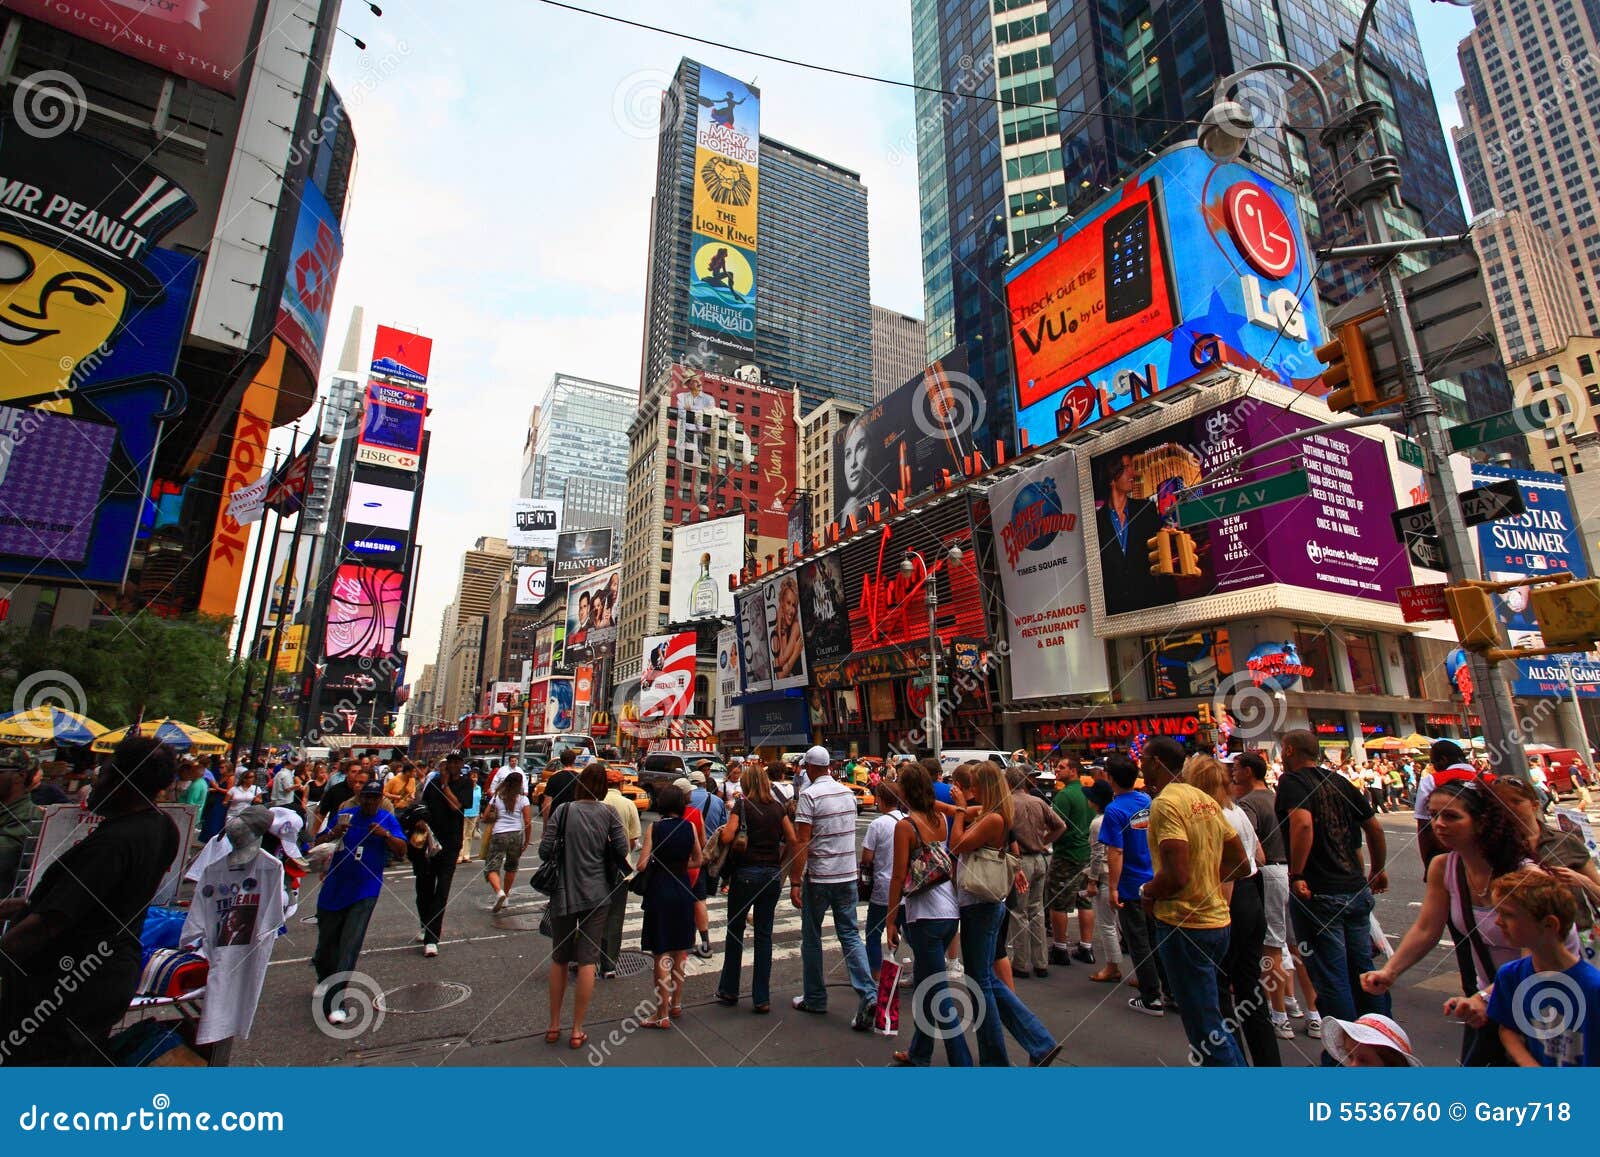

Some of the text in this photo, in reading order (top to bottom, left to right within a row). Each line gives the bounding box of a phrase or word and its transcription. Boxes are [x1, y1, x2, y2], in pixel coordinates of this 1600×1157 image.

[176, 51, 232, 80] STYLE
[700, 131, 757, 162] POPPINS
[709, 124, 750, 149] MARY
[0, 176, 147, 259] MR. PEANUT
[717, 210, 737, 224] THE
[696, 215, 755, 245] LION KING
[1012, 268, 1097, 325] Check out the
[691, 303, 754, 333] MERMAID
[705, 303, 742, 317] THE LITTLE
[1080, 311, 1091, 322] by
[1091, 300, 1104, 315] LG
[1240, 274, 1309, 342] LG
[379, 395, 416, 408] PREMIER
[380, 387, 404, 399] HSBC
[764, 394, 788, 448] Valdez
[1472, 424, 1486, 442] 7
[360, 448, 397, 464] HSBC
[1204, 458, 1211, 469] A
[1211, 446, 1243, 468] NIGHT
[1303, 457, 1322, 472] PLANET
[1326, 451, 1340, 464] MORE
[1340, 456, 1348, 466] TO
[764, 450, 788, 496] Juan
[1214, 489, 1266, 513] 7 Av
[1312, 488, 1327, 501] NEED
[1328, 492, 1335, 503] TO
[1336, 494, 1345, 507] GET
[1346, 498, 1356, 510] OUT
[1462, 498, 1498, 518] WAY
[516, 511, 554, 525] RENT
[1223, 515, 1241, 527] NEW
[1322, 505, 1335, 517] NEW
[1000, 500, 1046, 556] PLANET
[1219, 522, 1248, 536] RESORT
[1316, 517, 1331, 531] ONCE
[1332, 522, 1338, 532] IN
[354, 540, 396, 552] SAMSUNG
[1008, 513, 1077, 571] HOLLYWOOD
[1228, 541, 1243, 552] LAS
[1230, 534, 1239, 542] IN
[1492, 525, 1569, 554] SUMMER
[557, 557, 608, 571] PHANTOM
[1322, 545, 1379, 567] planet hollywood
[1016, 557, 1068, 577] TIMES SQUARE
[1400, 590, 1412, 598] NO
[1014, 604, 1086, 627] WORLD-FAMOUS
[1021, 619, 1080, 639] RESTAURANT
[1037, 636, 1065, 649] & BAR
[1572, 667, 1600, 681] GAME
[1040, 721, 1100, 739] PLANET
